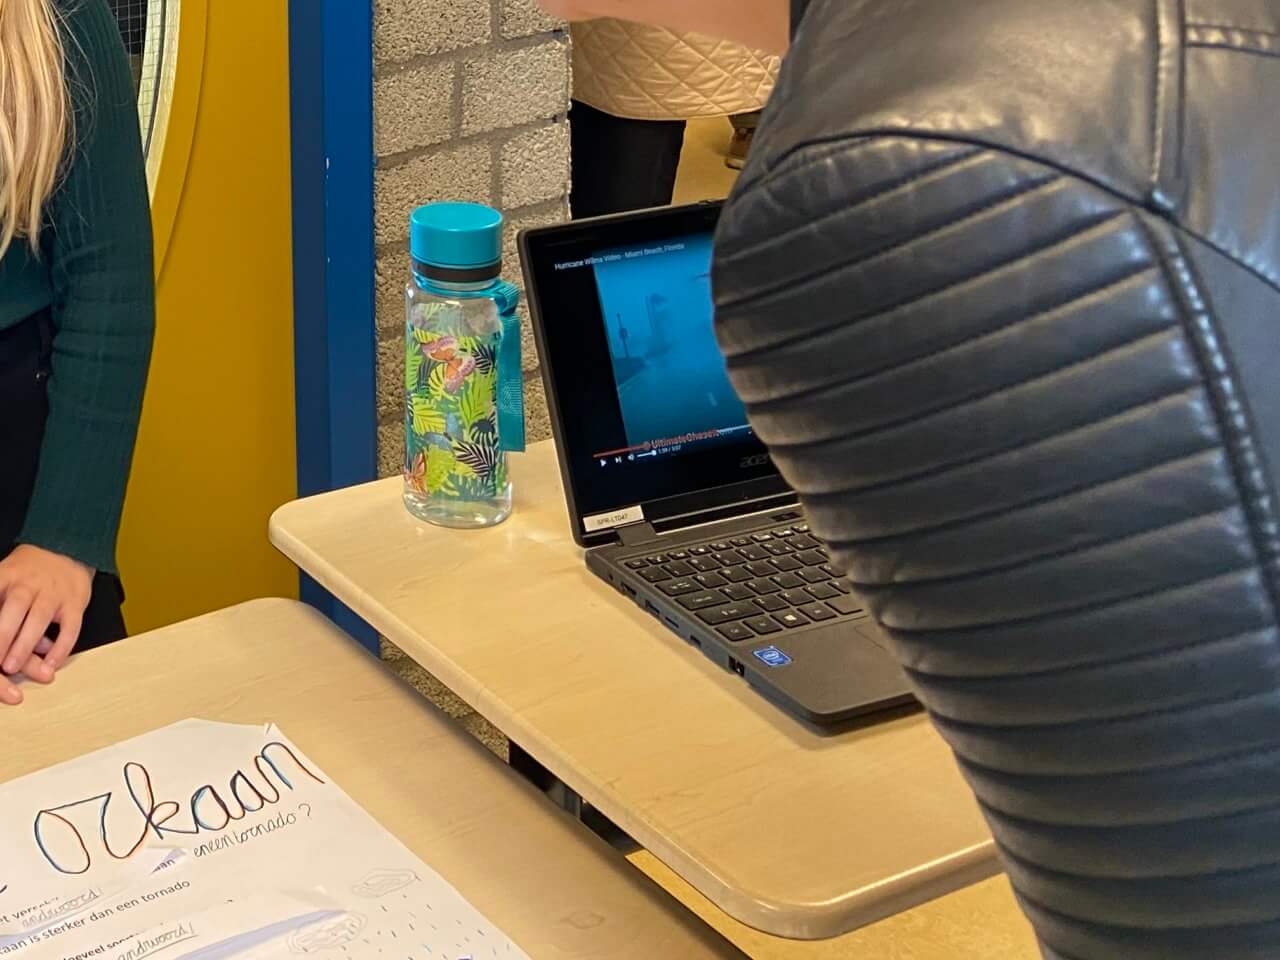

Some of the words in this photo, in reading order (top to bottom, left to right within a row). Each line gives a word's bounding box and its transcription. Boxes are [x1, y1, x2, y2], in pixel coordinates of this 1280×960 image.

[739, 453, 769, 468] ace
[29, 934, 41, 944] is
[42, 918, 86, 940] sterker
[89, 908, 115, 923] dan
[116, 895, 141, 912] een
[140, 879, 191, 905] tornado
